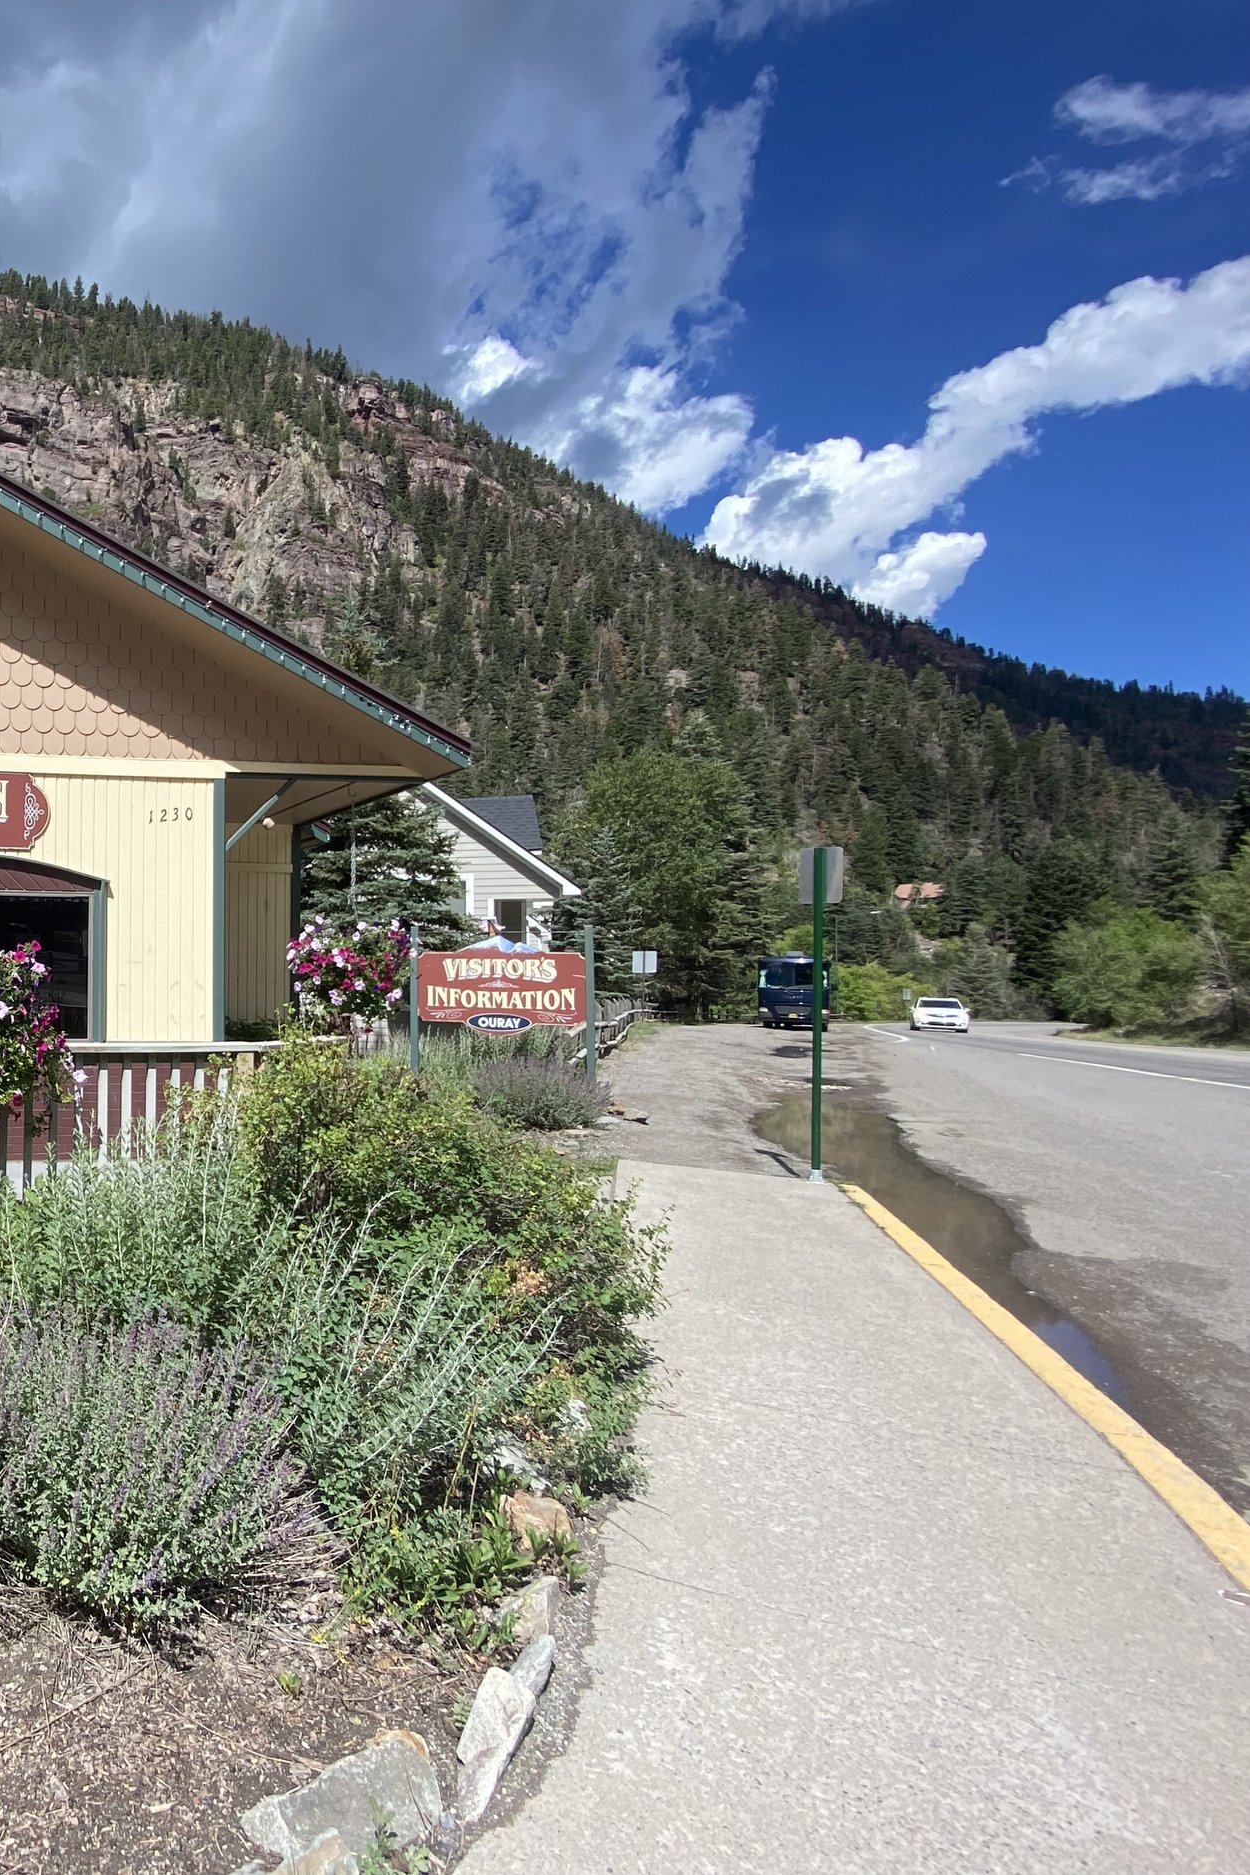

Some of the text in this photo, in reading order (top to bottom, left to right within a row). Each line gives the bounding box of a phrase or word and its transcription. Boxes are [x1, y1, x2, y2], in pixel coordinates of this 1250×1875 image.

[149, 807, 193, 824] 1230
[443, 957, 558, 983] VISITOR'S
[426, 985, 576, 1011] INFORMATION
[477, 1017, 521, 1029] OURAY
